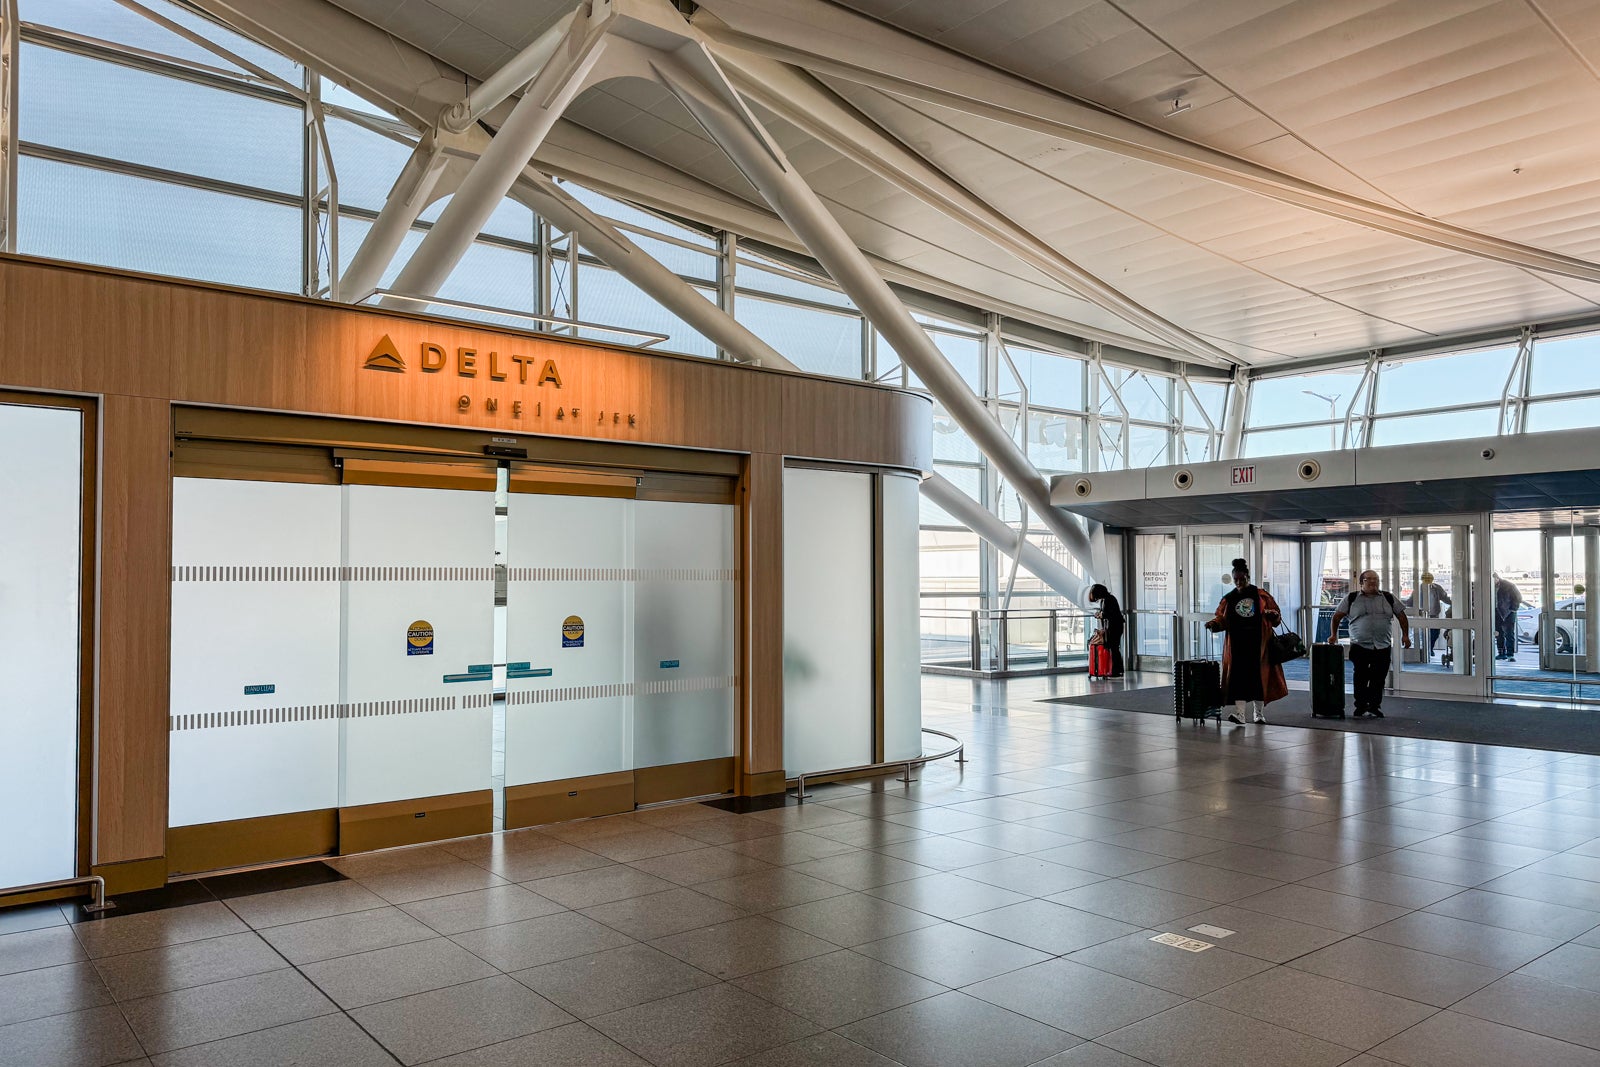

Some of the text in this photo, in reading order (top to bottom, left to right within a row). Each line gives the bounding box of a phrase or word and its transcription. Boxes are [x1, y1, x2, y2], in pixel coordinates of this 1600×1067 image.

[422, 342, 562, 387] DELTA
[458, 395, 522, 415] ONE
[598, 410, 636, 425] JFK
[1232, 466, 1254, 484] EXIT
